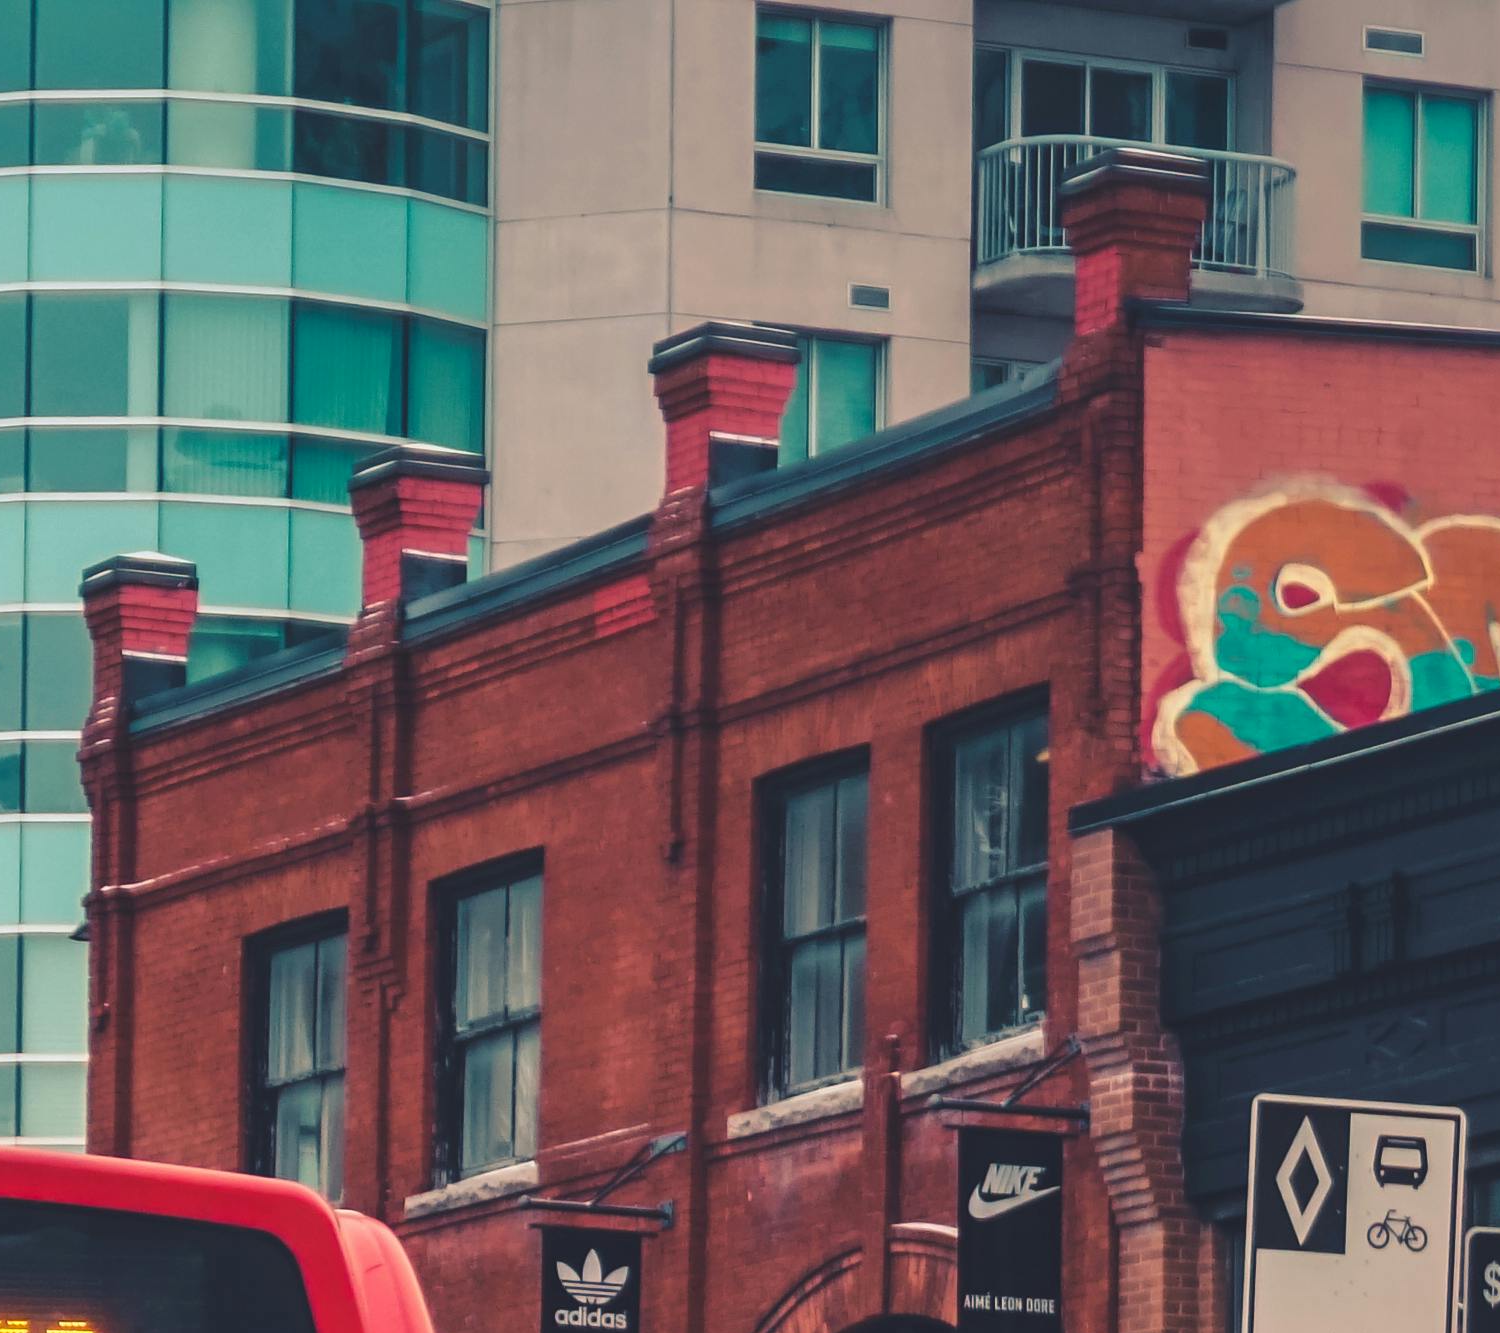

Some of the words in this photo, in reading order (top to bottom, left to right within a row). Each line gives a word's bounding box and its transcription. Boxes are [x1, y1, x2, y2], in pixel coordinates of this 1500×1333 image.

[981, 1162, 1043, 1195] NIKE
[963, 1292, 991, 1310] AIMÉ
[994, 1295, 1023, 1312] LEON
[1026, 1297, 1056, 1315] DORE
[554, 1306, 628, 1330] adidas
